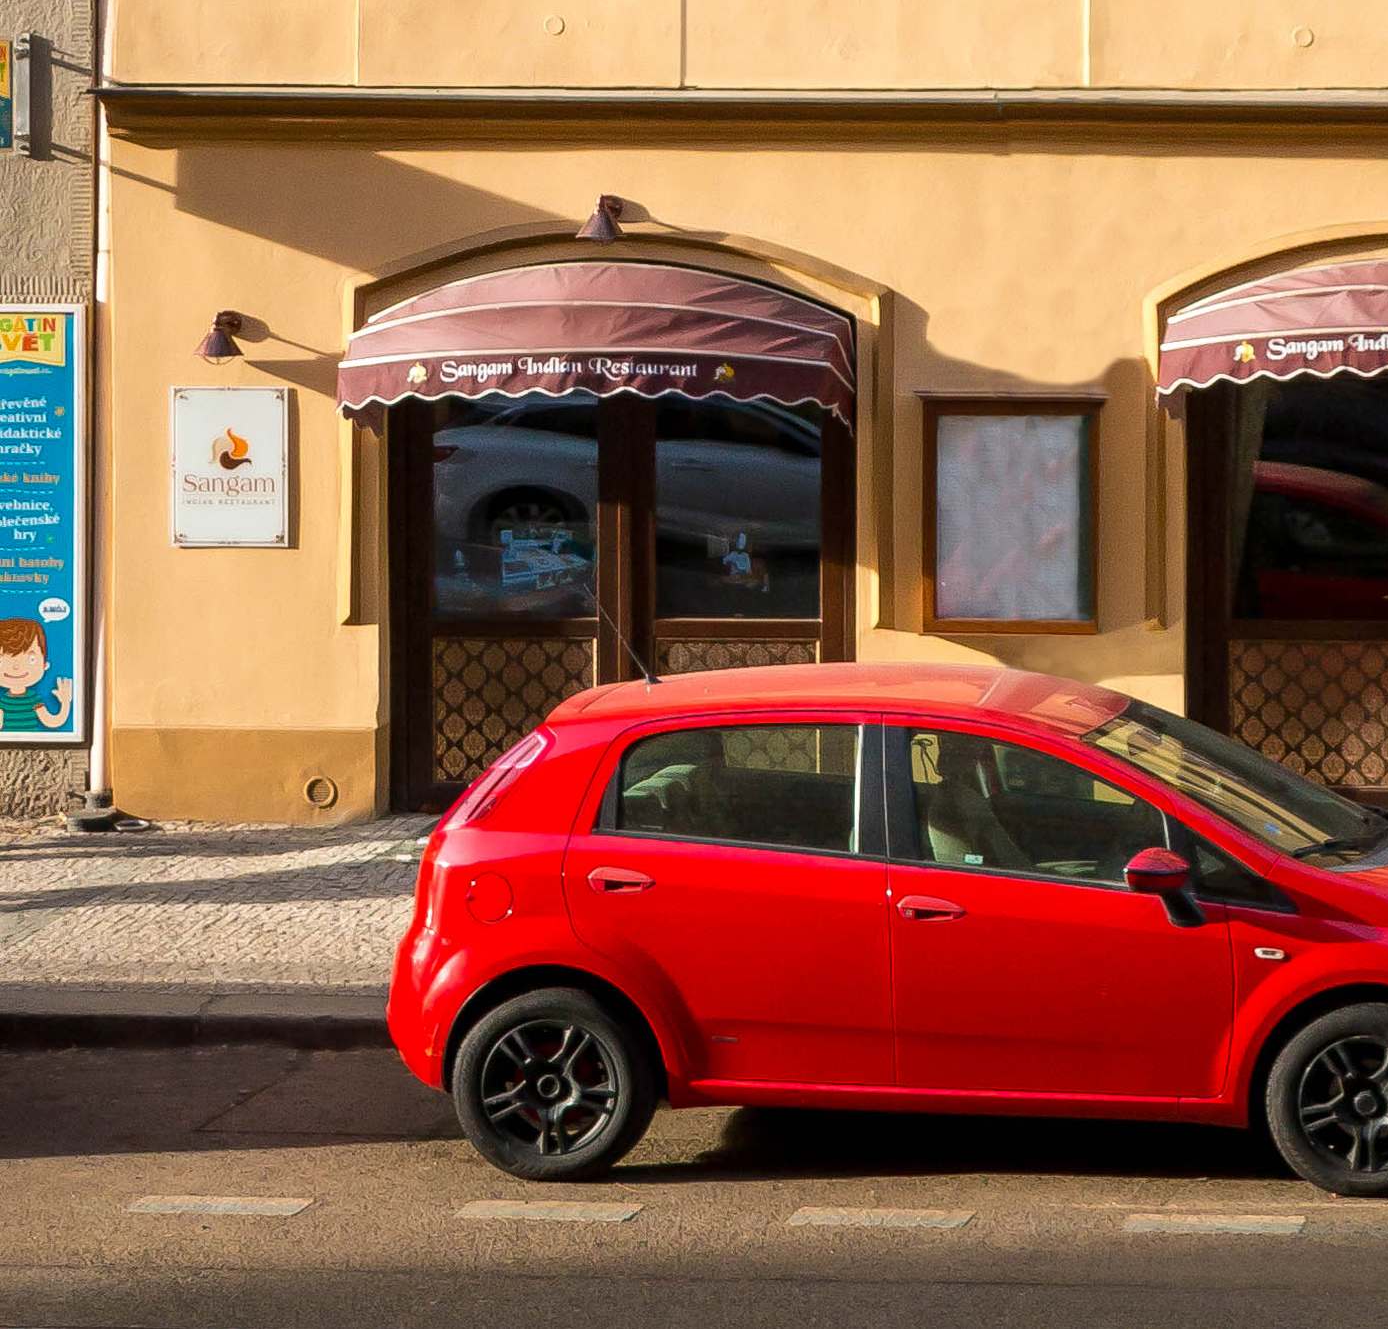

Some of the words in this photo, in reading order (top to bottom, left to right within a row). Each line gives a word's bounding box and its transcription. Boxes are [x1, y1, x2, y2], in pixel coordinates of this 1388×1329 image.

[1266, 338, 1344, 361] Sangam
[440, 360, 513, 383] Sangam
[518, 355, 583, 376] Indian
[589, 356, 699, 382] Restaurant
[183, 473, 276, 497] Sangam
